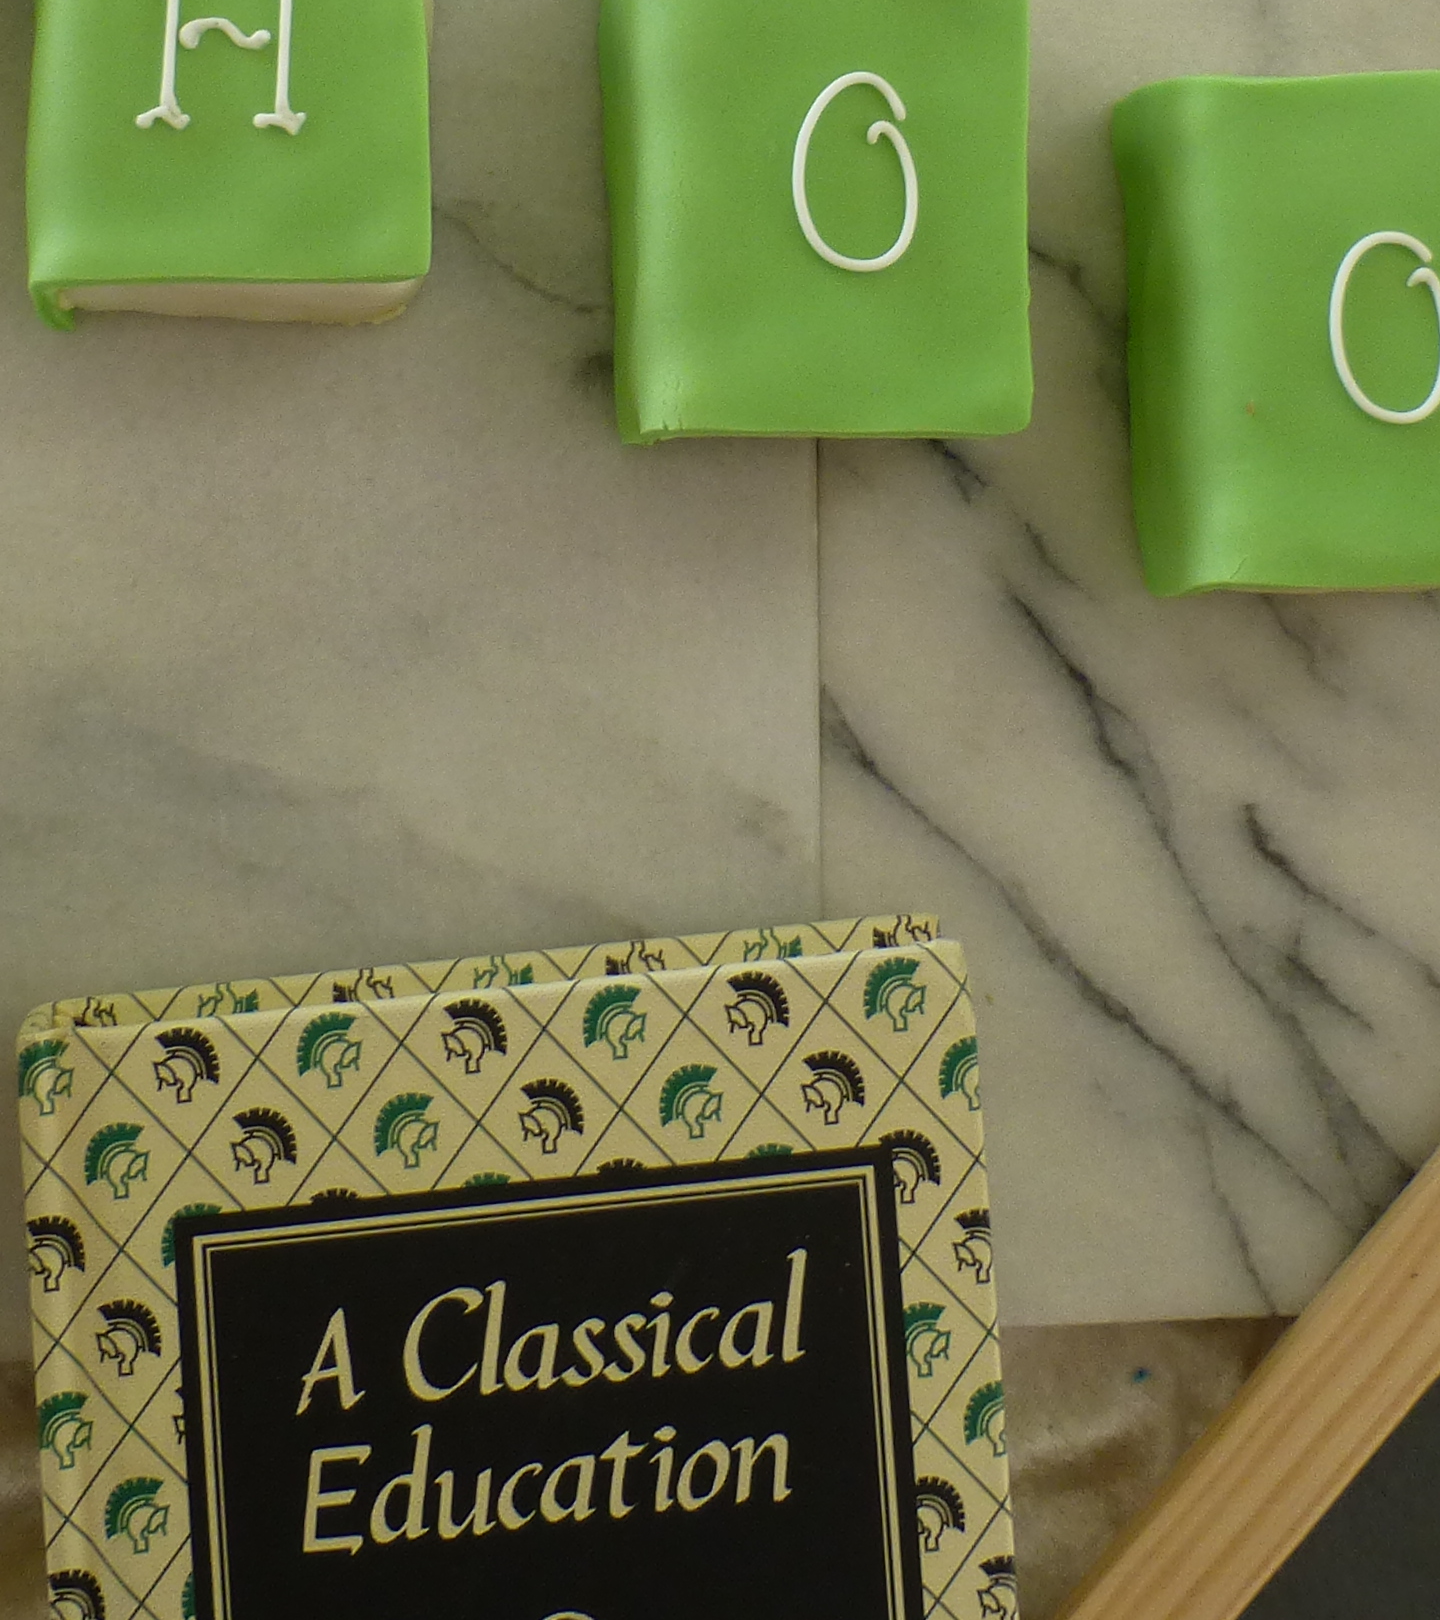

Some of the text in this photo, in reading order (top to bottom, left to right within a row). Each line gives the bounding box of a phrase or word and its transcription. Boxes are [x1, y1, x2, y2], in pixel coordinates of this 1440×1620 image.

[294, 1248, 808, 1416] A Classical
[302, 1422, 794, 1557] Education
